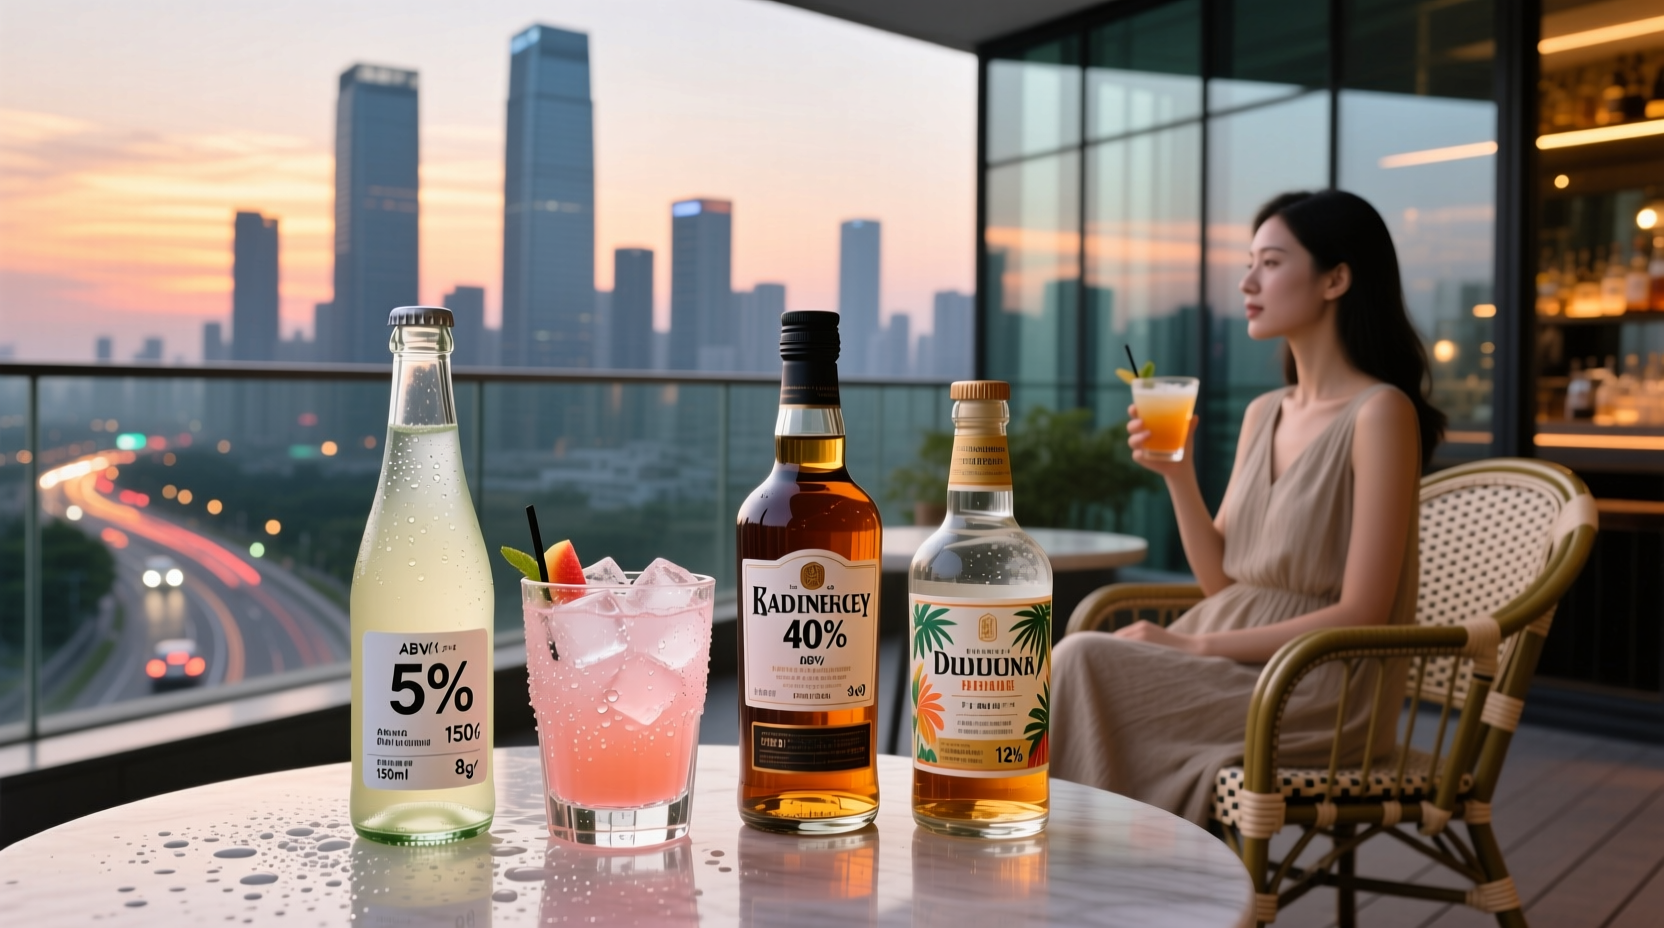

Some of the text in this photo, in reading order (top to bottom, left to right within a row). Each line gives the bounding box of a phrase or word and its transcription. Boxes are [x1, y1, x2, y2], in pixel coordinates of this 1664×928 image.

[783, 619, 847, 649] 40%
[390, 661, 474, 715] 5%
[995, 746, 1023, 763] 12%
[377, 768, 409, 780] 150ml
